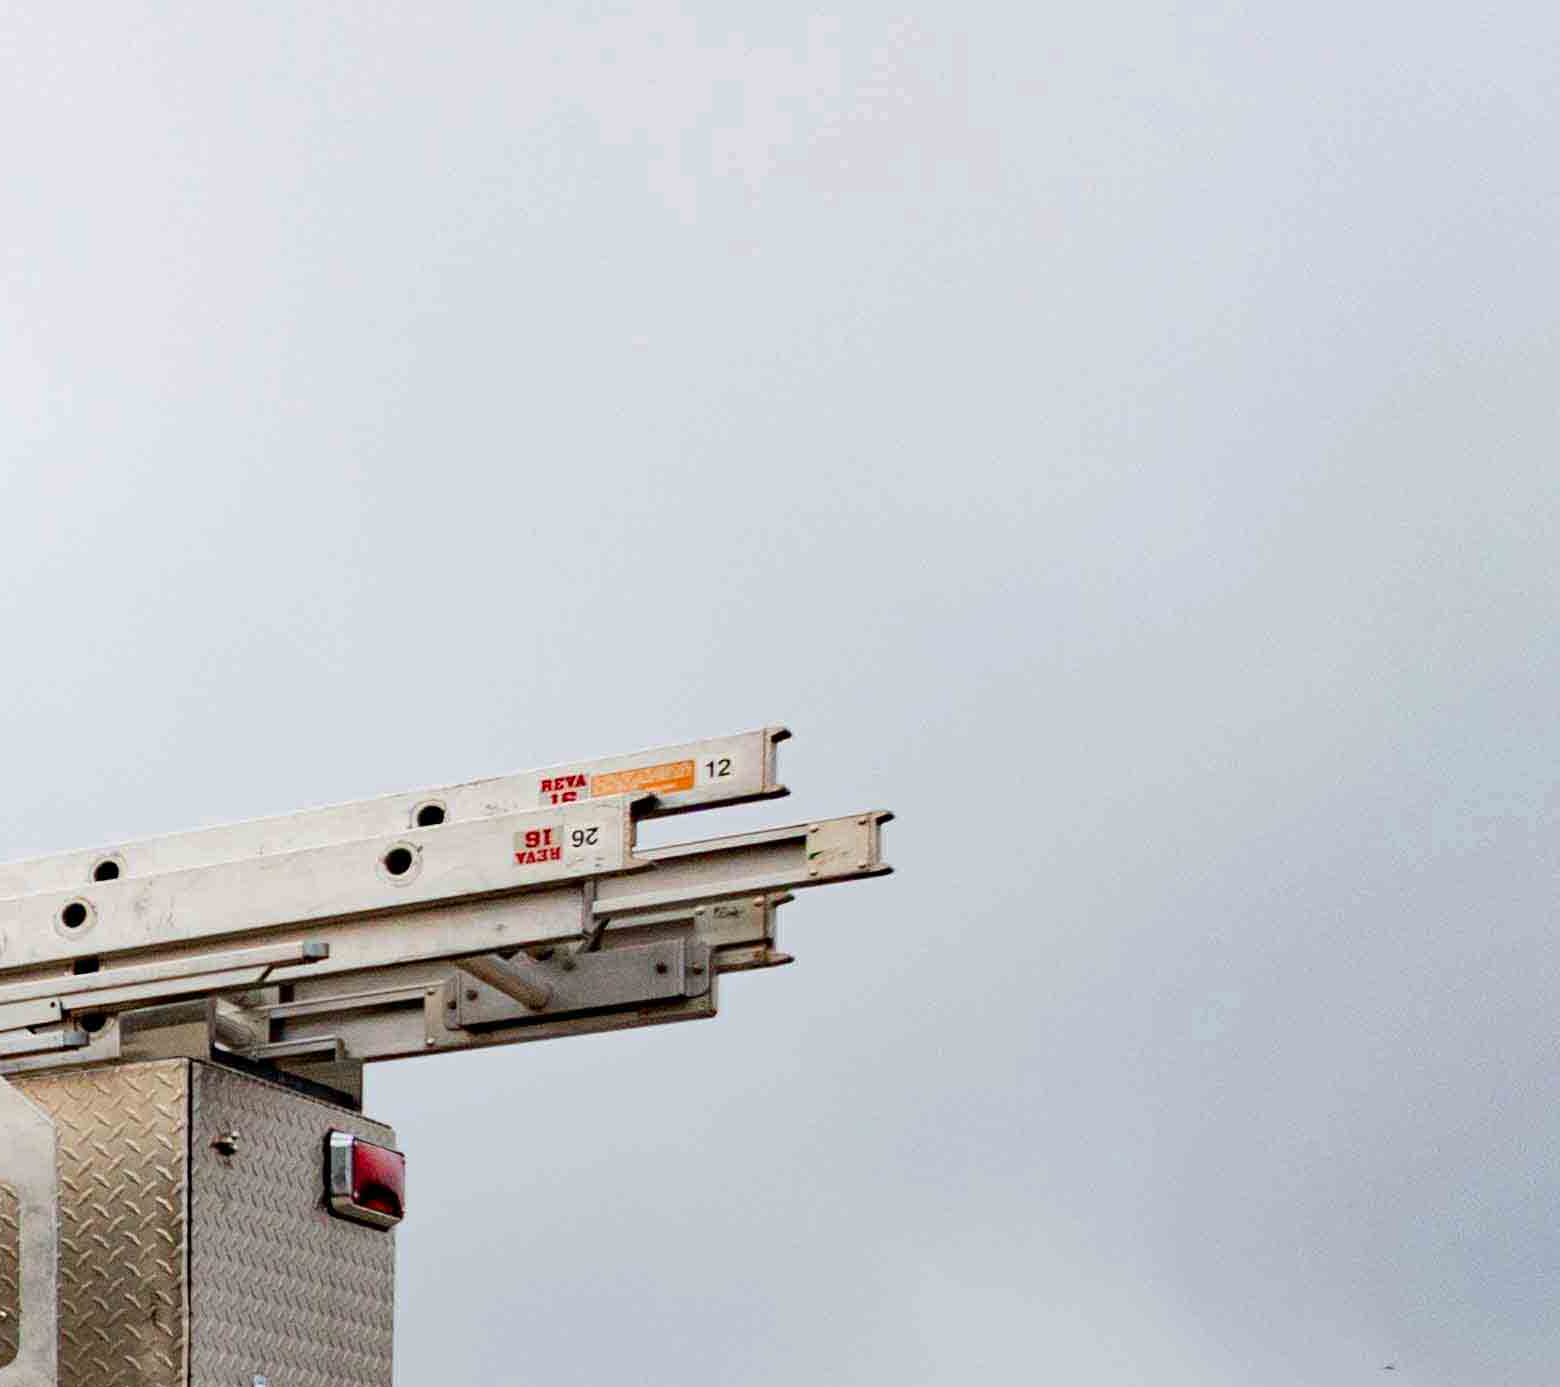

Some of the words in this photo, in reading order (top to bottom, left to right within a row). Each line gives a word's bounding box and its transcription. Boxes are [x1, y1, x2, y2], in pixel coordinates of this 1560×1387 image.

[705, 758, 731, 778] 12
[524, 828, 553, 848] 16
[571, 827, 599, 848] 26
